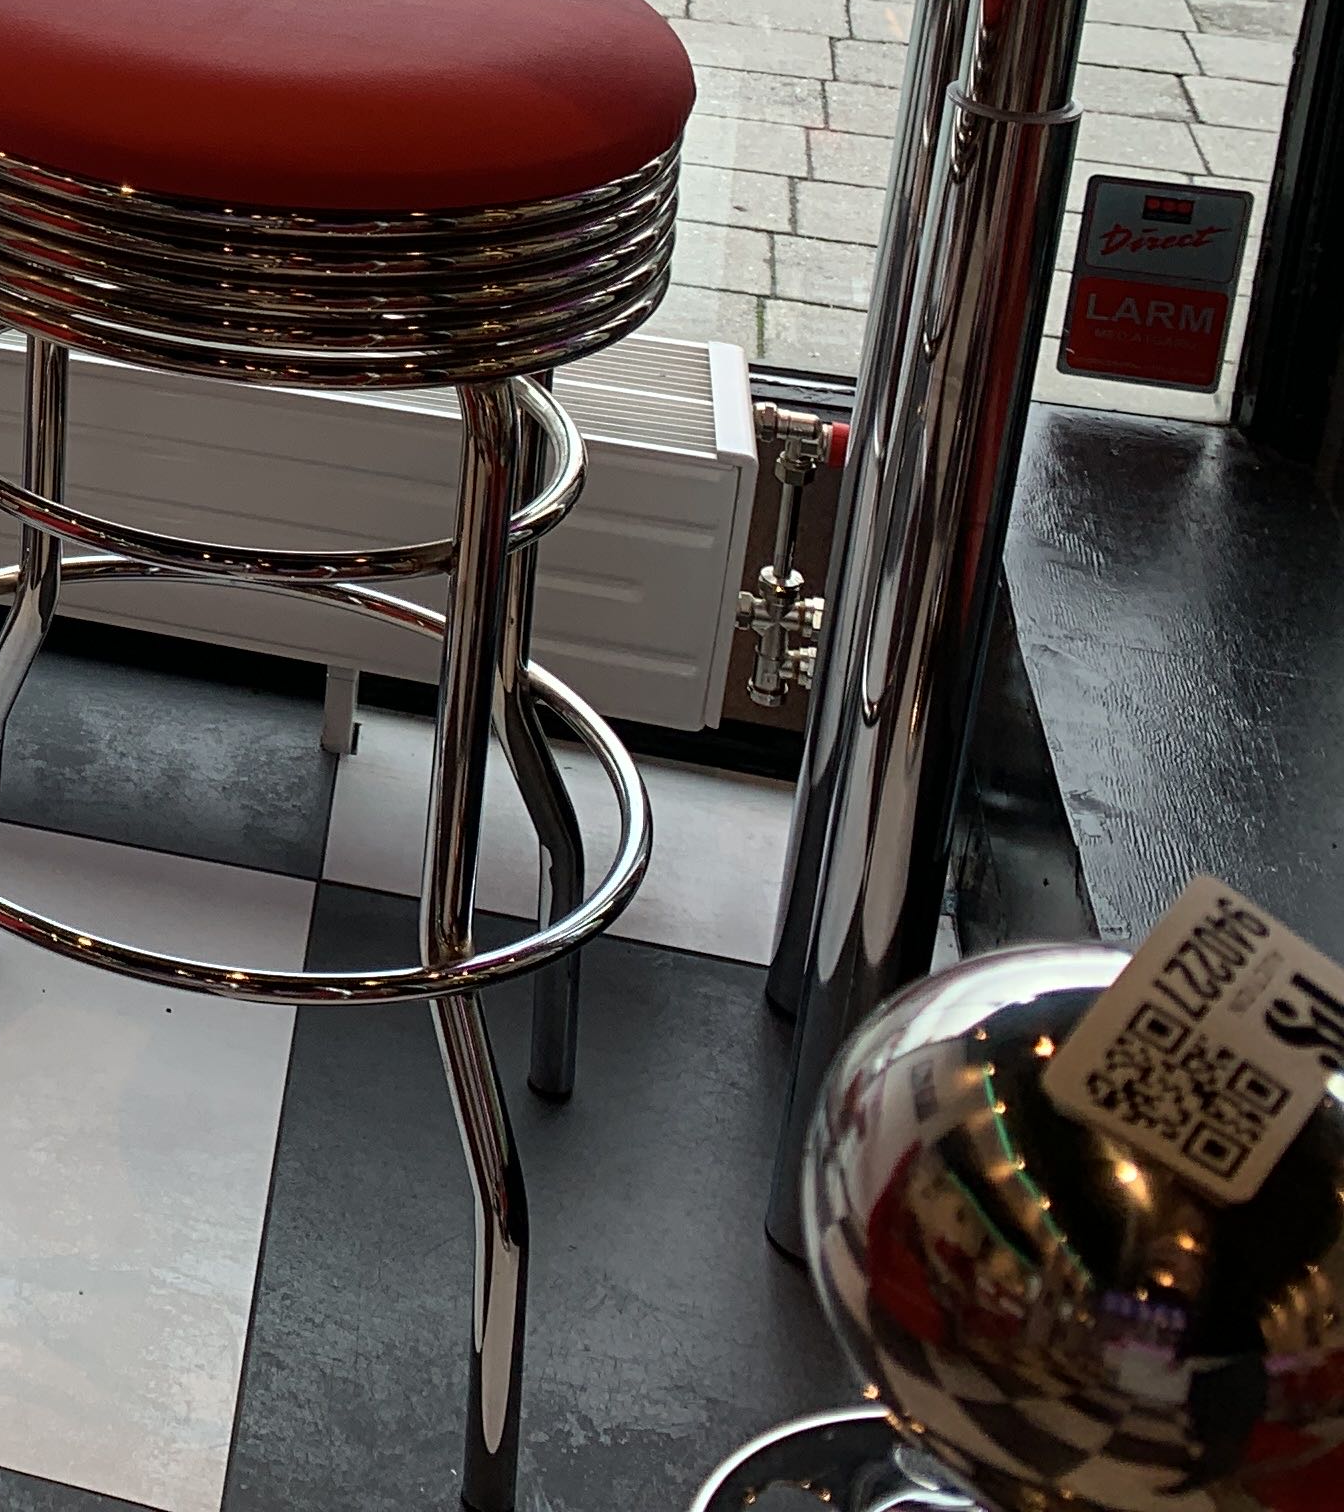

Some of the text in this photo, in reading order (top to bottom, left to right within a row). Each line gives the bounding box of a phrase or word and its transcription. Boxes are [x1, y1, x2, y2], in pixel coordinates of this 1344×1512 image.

[1099, 223, 1231, 256] Direct
[1086, 293, 1216, 334] LARM
[1153, 898, 1270, 1021] 940227
